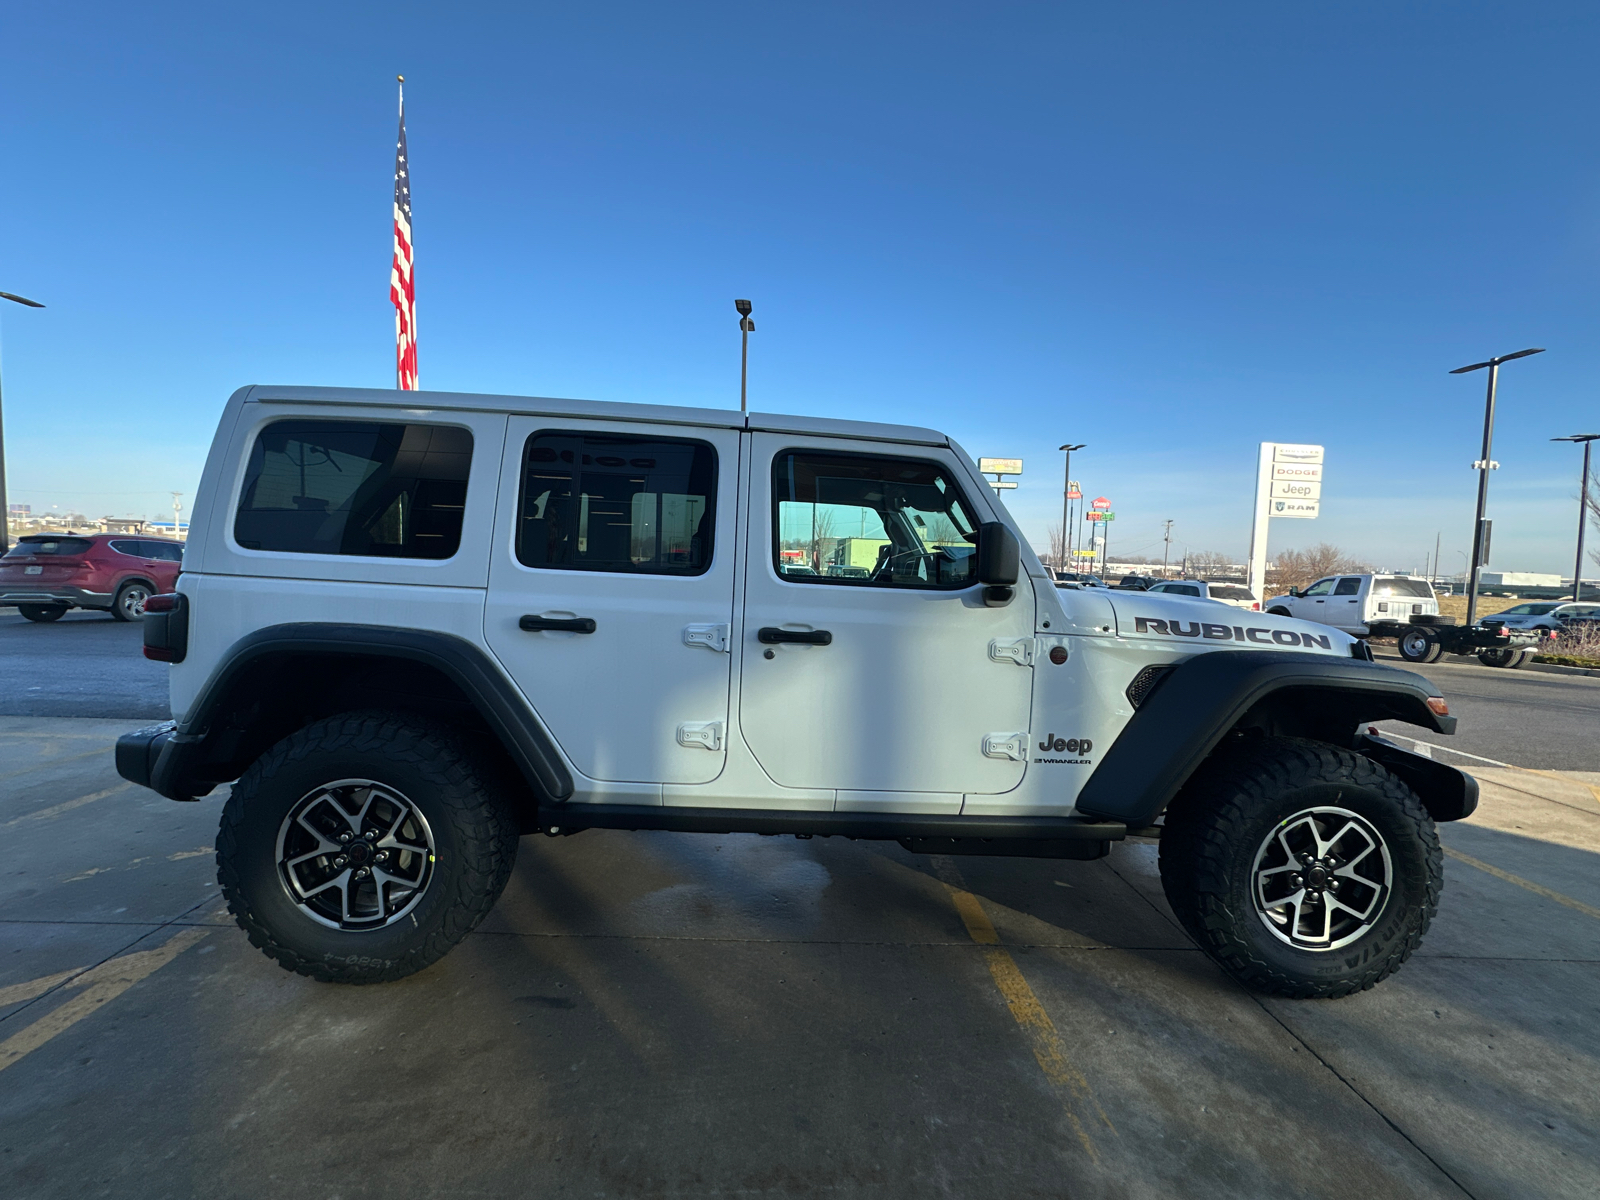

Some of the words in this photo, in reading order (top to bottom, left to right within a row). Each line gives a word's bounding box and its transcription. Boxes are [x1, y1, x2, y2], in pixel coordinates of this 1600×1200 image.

[1282, 483, 1311, 496] Jeep
[1134, 617, 1332, 650] RUBICON
[1039, 733, 1093, 756] Jeep
